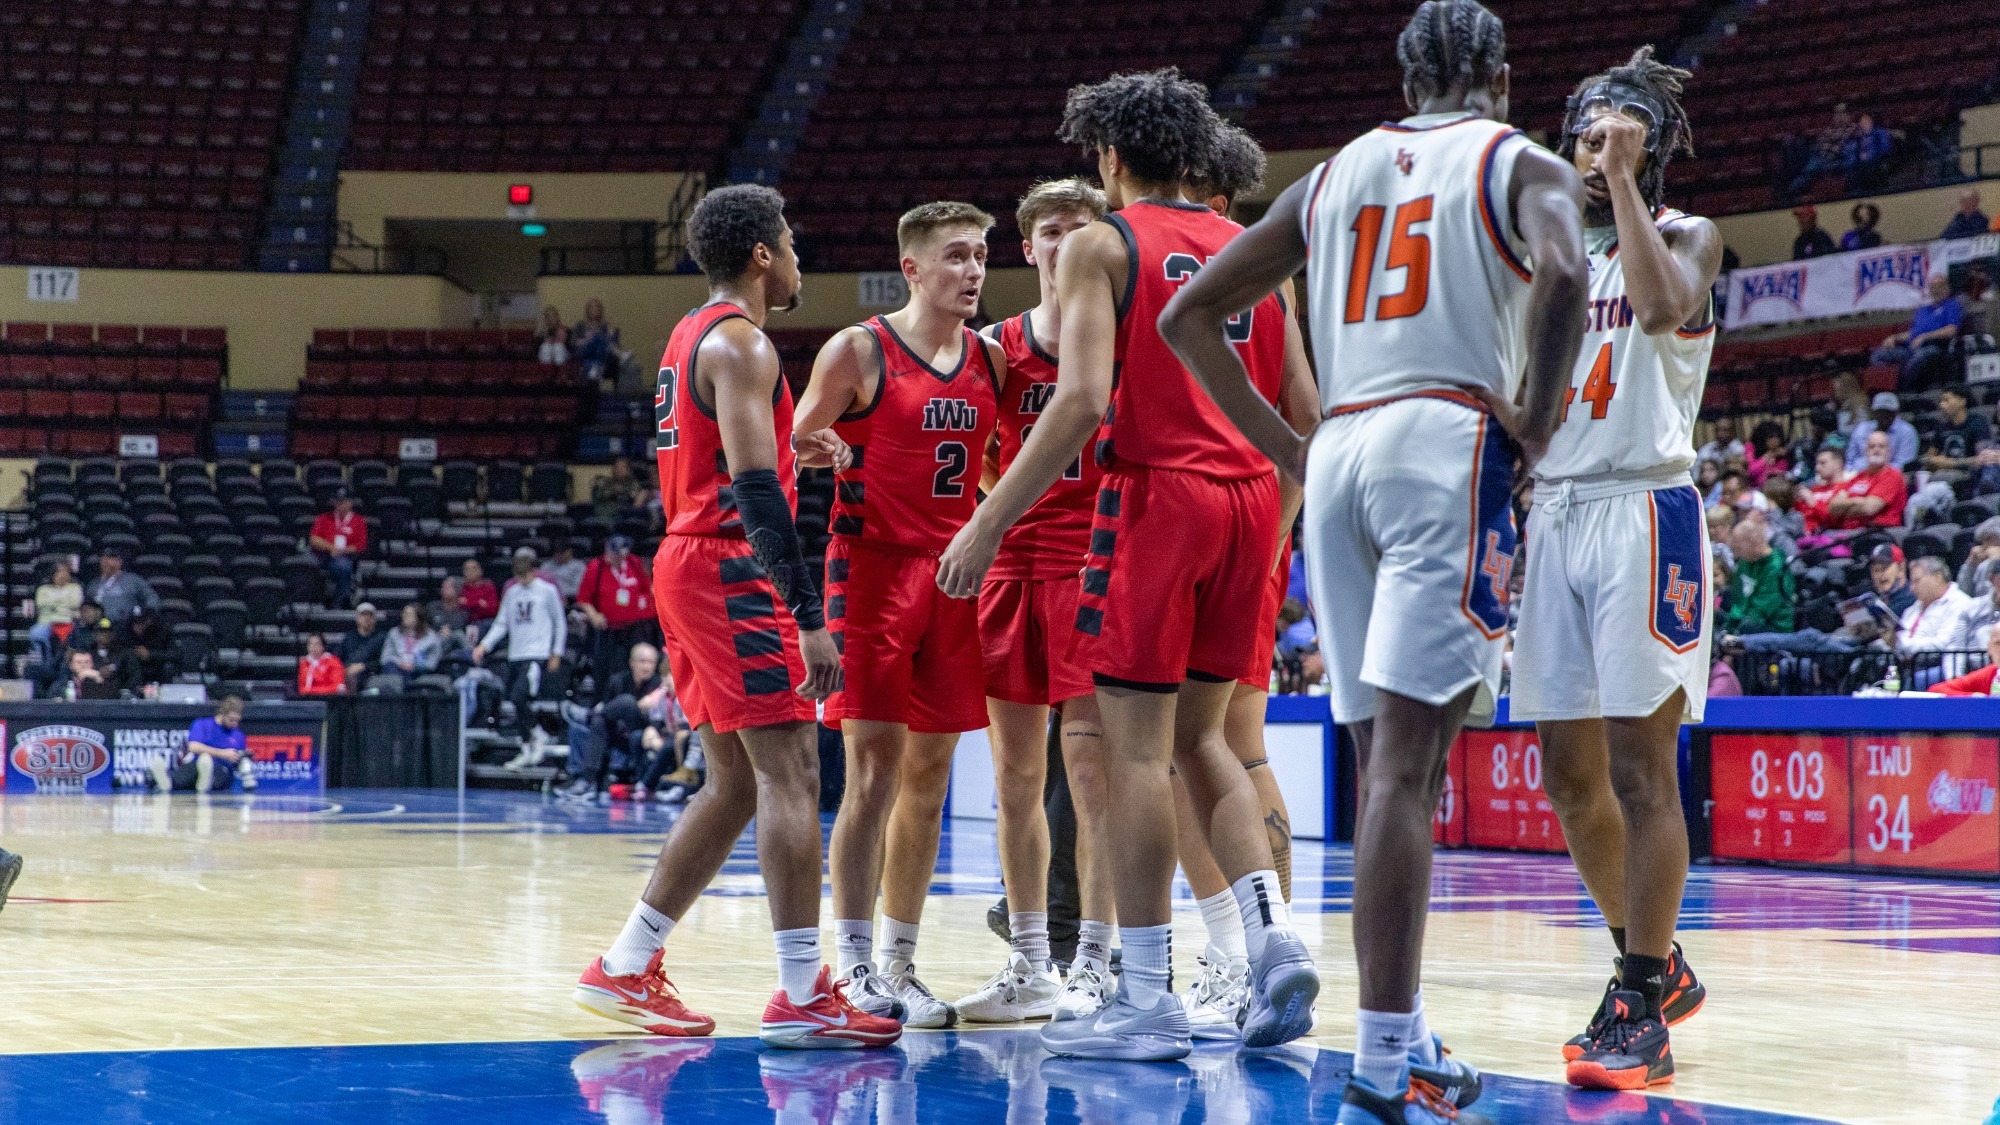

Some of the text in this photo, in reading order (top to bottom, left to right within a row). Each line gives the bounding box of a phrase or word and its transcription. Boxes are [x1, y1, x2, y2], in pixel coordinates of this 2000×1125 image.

[1344, 193, 1434, 324] 15
[1859, 254, 1925, 293] NAIA
[33, 272, 74, 296] 117
[864, 277, 902, 302] 115
[1742, 271, 1800, 302] NAIA
[922, 398, 977, 432] IWU
[932, 441, 968, 498] 2
[1664, 563, 1699, 619] LU
[114, 729, 190, 747] KANSAS CIT
[26, 742, 95, 773] 810
[1867, 745, 1911, 777] IWU
[1750, 750, 1825, 800] 8:03
[1753, 828, 1761, 846] 2
[1868, 794, 1913, 853] 34
